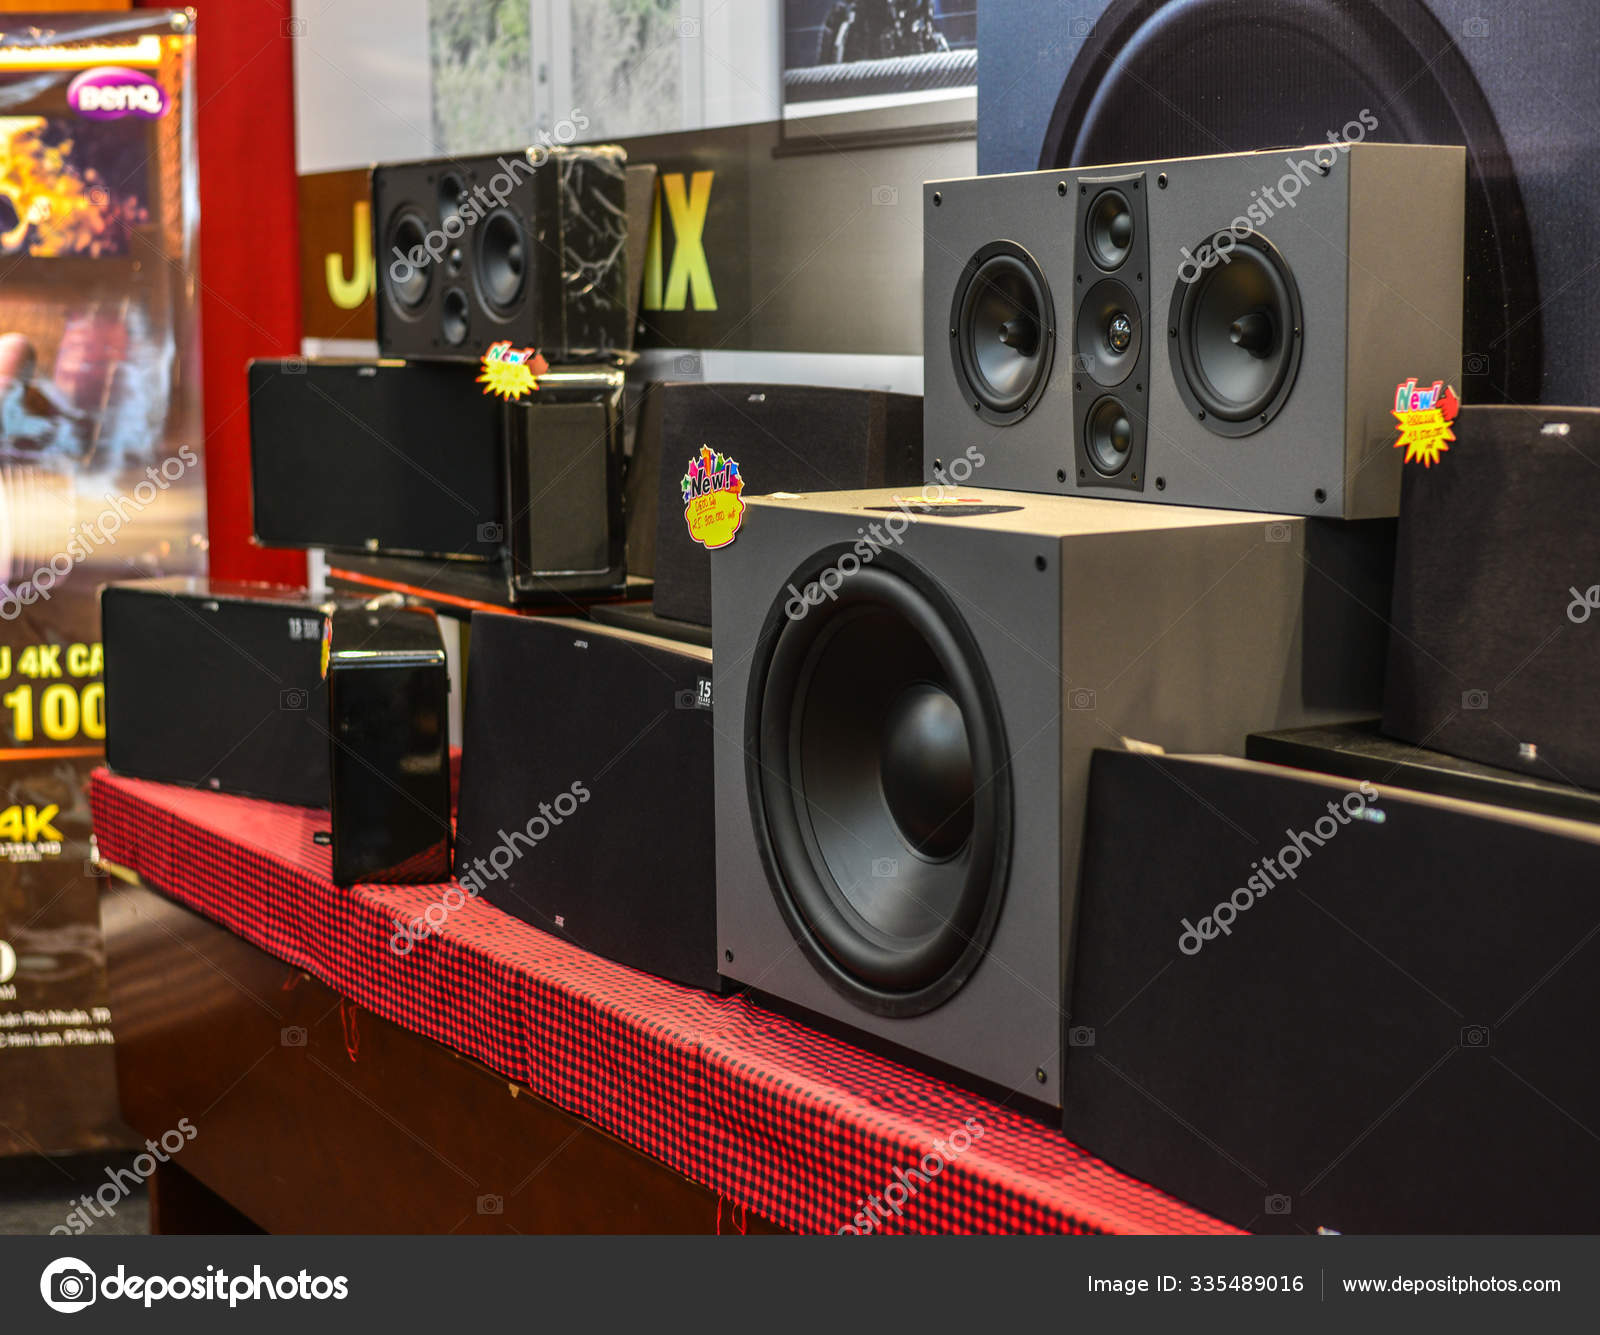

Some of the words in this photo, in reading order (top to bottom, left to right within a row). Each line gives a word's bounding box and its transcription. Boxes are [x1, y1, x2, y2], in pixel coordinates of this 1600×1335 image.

[1397, 382, 1440, 411] New!
[692, 464, 732, 498] New!
[18, 645, 62, 678] 4K
[699, 680, 711, 697] 15
